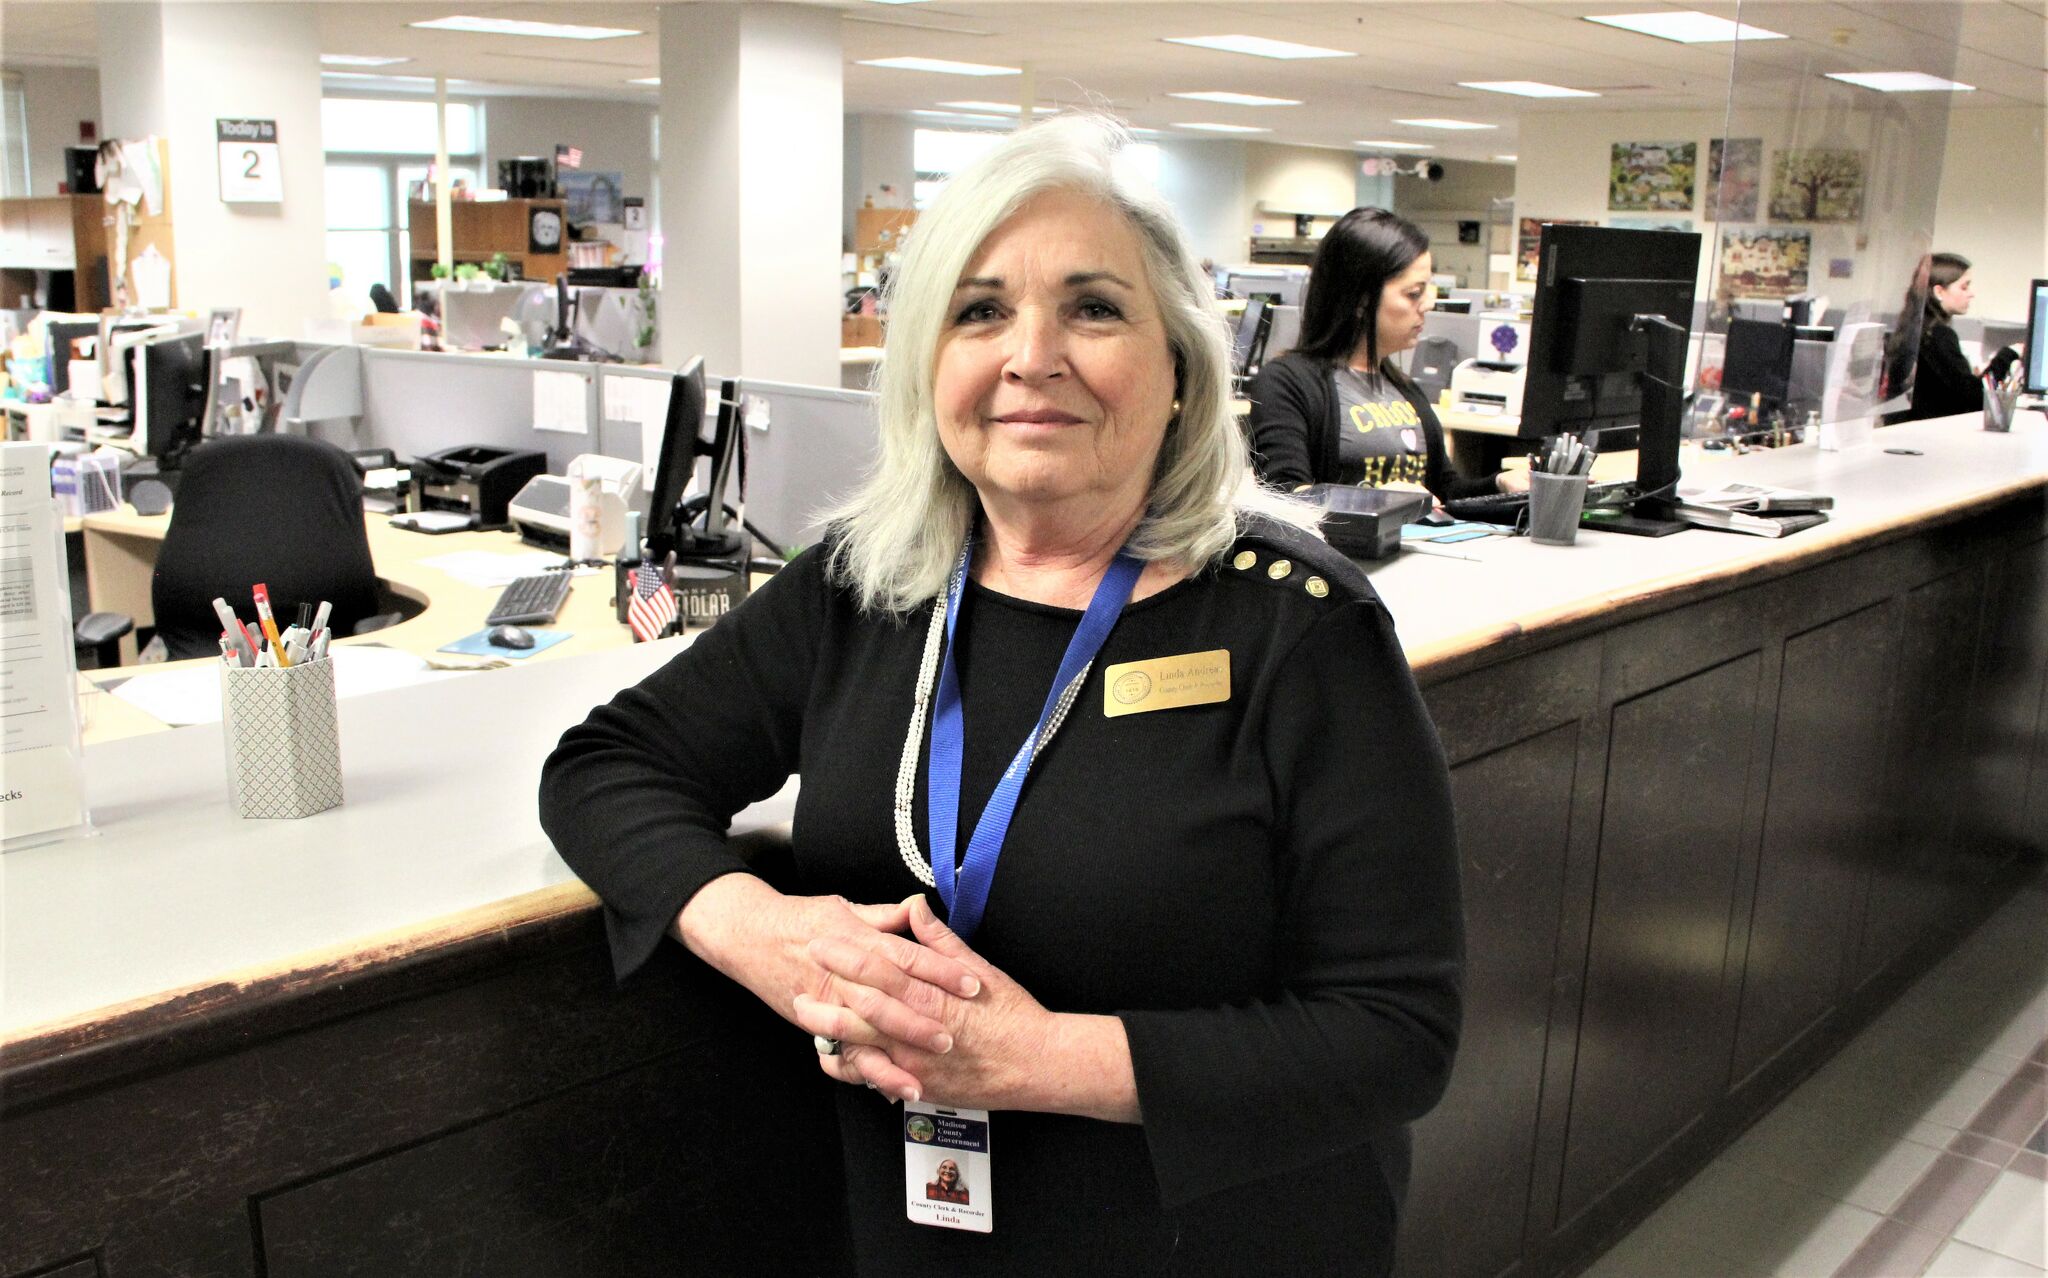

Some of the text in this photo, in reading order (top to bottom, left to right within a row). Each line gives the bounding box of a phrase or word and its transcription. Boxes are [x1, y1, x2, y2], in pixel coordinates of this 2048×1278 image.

[220, 120, 274, 139] Today is
[243, 149, 261, 178] 2
[1159, 668, 1185, 681] Linda
[937, 1120, 967, 1129] Madison
[937, 1128, 962, 1138] County
[937, 1136, 980, 1147] Government
[911, 1201, 932, 1209] County
[933, 1203, 949, 1212] Clerk
[958, 1208, 985, 1217] Recorder
[936, 1213, 960, 1224] Linda
